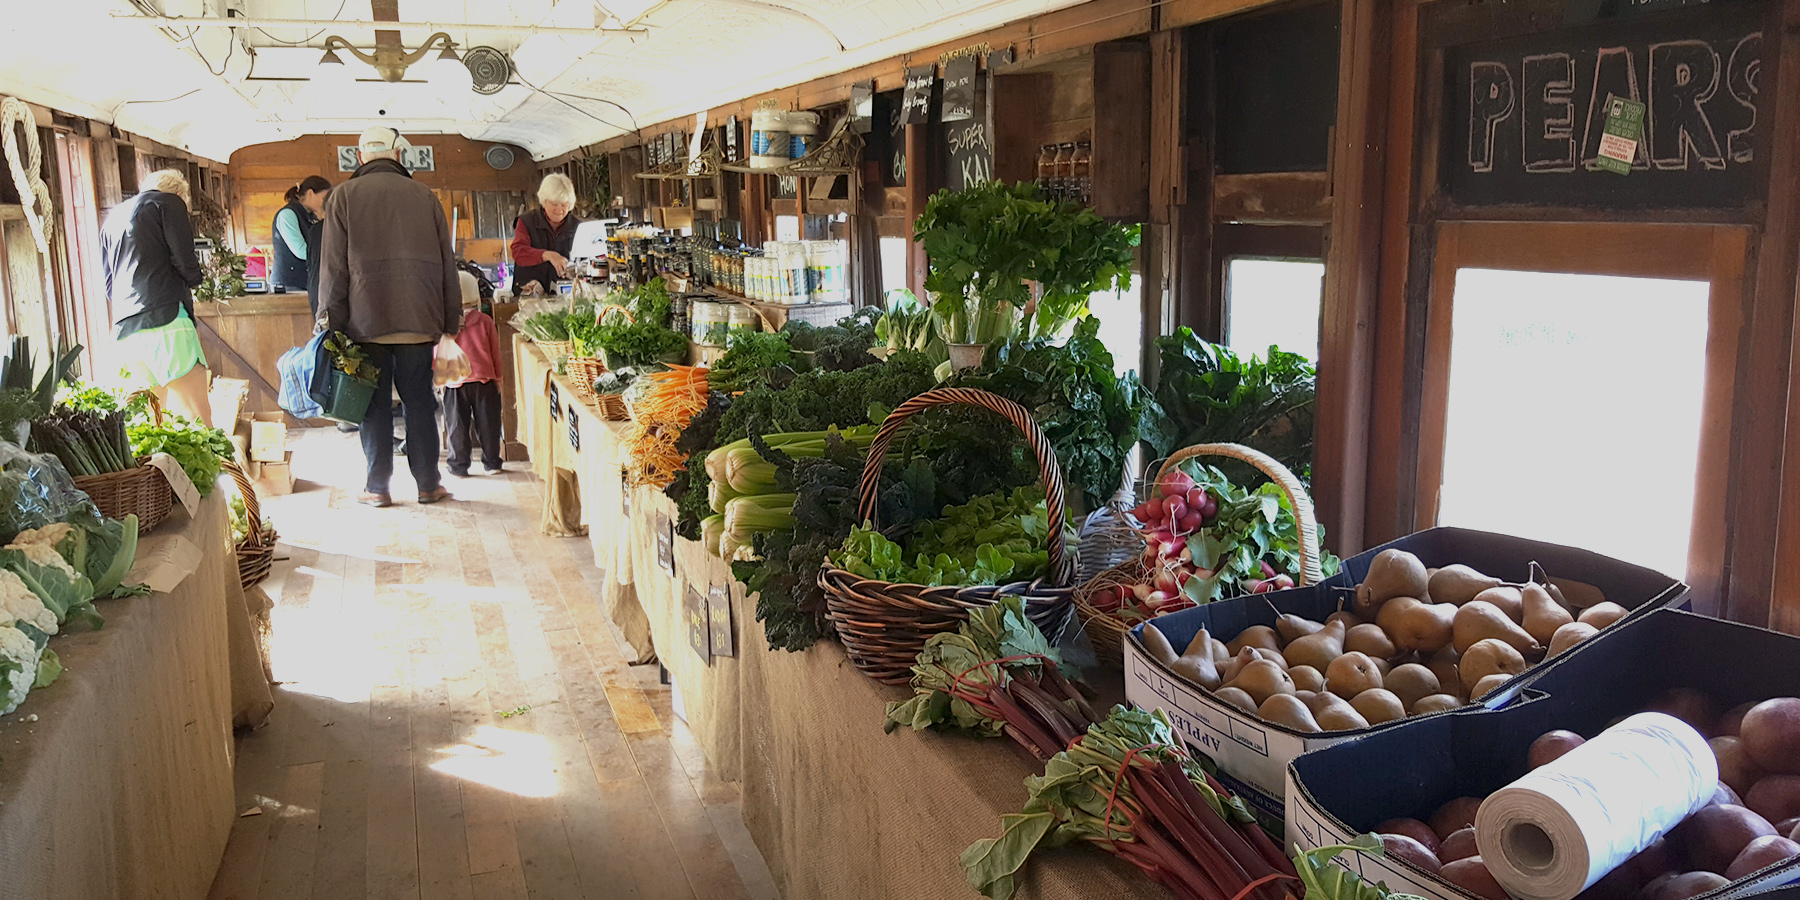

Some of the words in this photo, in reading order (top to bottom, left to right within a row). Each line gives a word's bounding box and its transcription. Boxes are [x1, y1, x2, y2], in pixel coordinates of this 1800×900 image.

[939, 52, 950, 69] NO
[951, 41, 991, 63] SMOKING
[1468, 31, 1762, 172] PEARS
[1603, 149, 1629, 160] WARNING
[1168, 710, 1221, 752] APPLES
